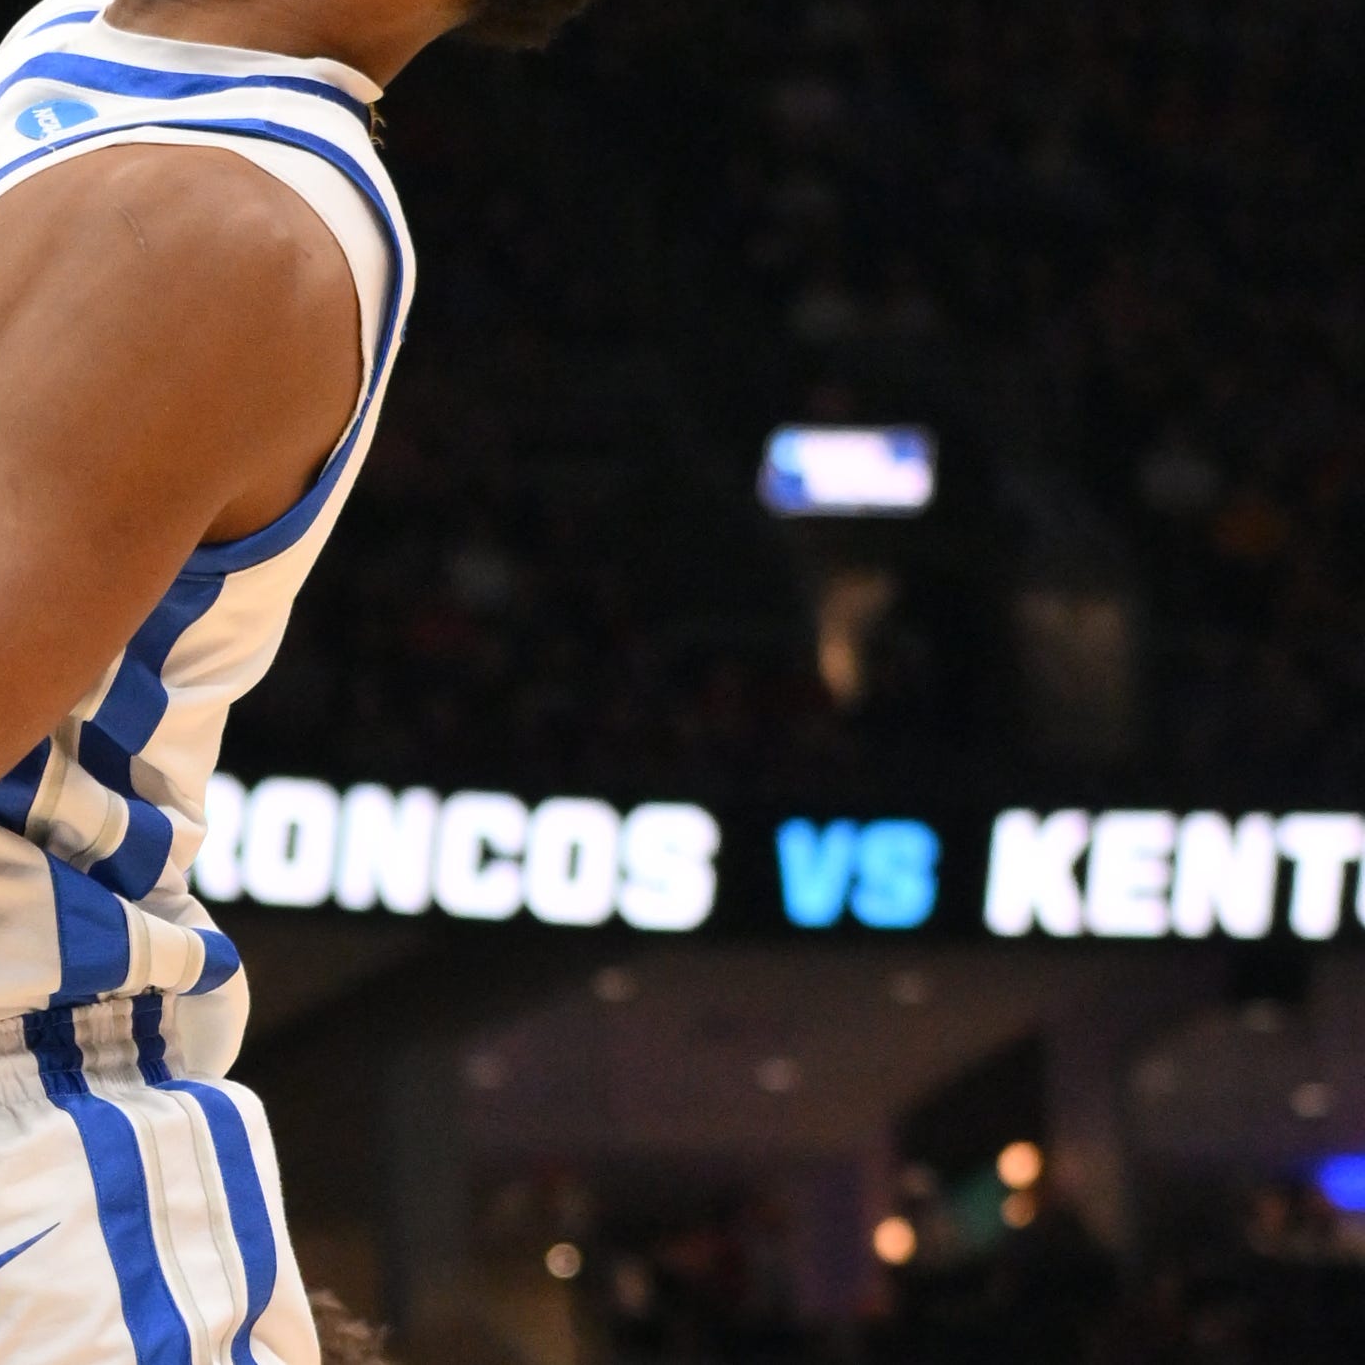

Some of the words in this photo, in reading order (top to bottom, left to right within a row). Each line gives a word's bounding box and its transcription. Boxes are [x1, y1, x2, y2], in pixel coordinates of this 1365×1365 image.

[190, 772, 720, 932] RONCOS
[776, 816, 940, 928] VS
[983, 807, 1365, 940] KENT
